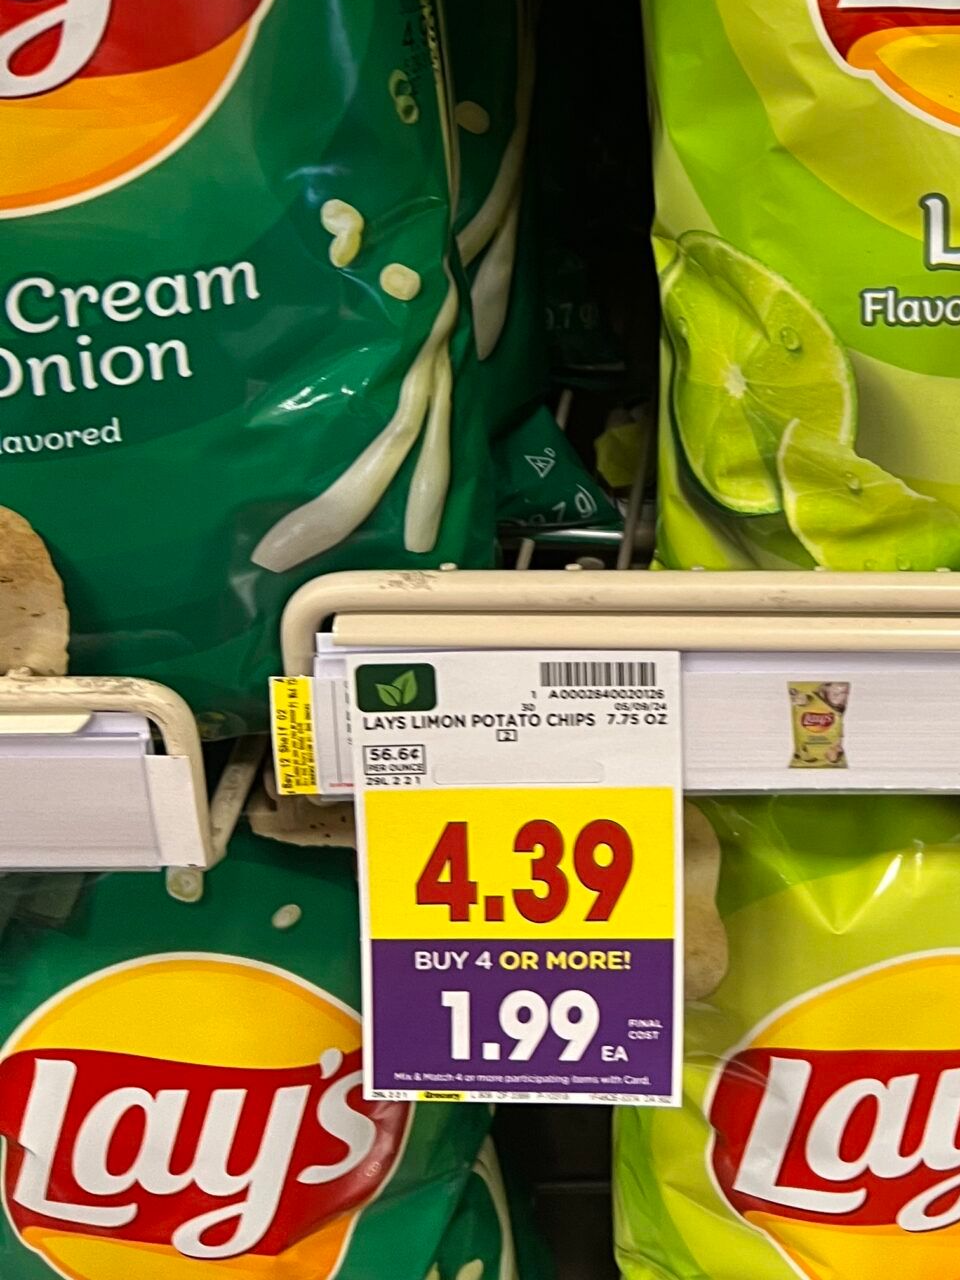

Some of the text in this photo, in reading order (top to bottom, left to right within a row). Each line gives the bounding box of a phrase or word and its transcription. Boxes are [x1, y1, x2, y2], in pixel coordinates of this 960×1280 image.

[4, 261, 261, 334] Cream
[362, 713, 668, 731] LAYS LIMON POTATO CHIPS 7.75 OZ
[369, 748, 421, 761] 56.6¢
[369, 763, 425, 772] PER OUNCE
[415, 818, 635, 924] 4.39
[413, 950, 632, 970] BUY 4 OR MORE!
[440, 988, 629, 1063] 1.99 EA
[627, 1018, 664, 1029] FINAL
[627, 1030, 661, 1040] COST
[12, 1046, 377, 1259] Lay's
